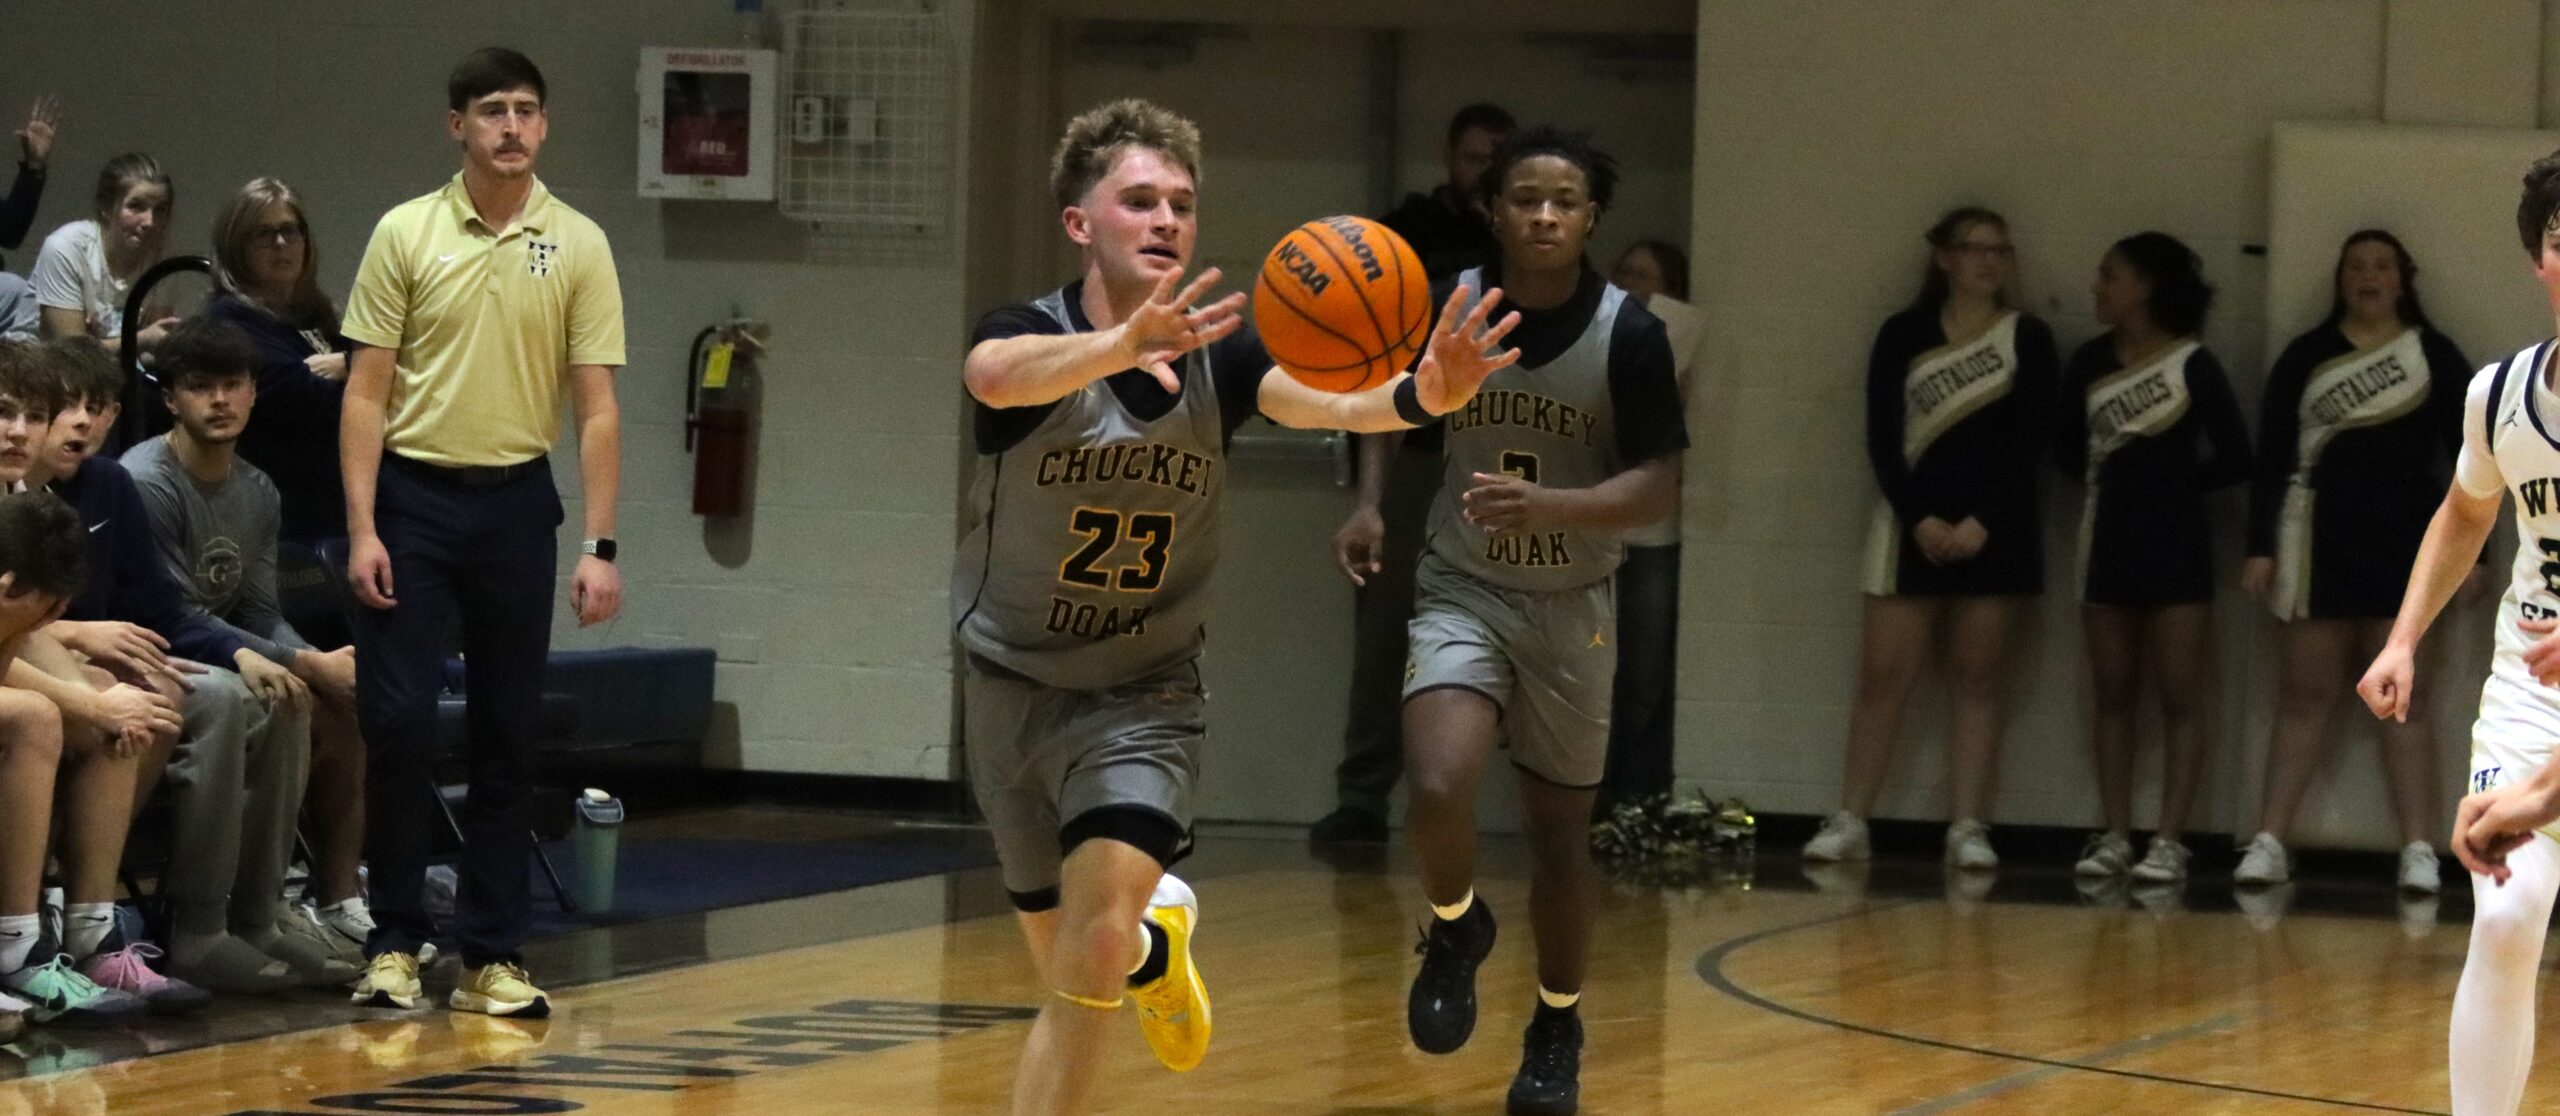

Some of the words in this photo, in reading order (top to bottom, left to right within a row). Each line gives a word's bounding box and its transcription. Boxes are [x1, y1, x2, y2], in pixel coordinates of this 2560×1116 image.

[1275, 240, 1332, 296] NCAA
[1910, 345, 2004, 415] BUFFALOES
[2310, 355, 2407, 425] BUFFALOES
[1451, 390, 1599, 448] CHUCKEY
[2519, 476, 2560, 519] W
[1058, 505, 1176, 592] 23
[1485, 531, 1571, 567] DOAK
[1045, 596, 1154, 641] DOAK
[224, 998, 1042, 1116] BUFFALO
